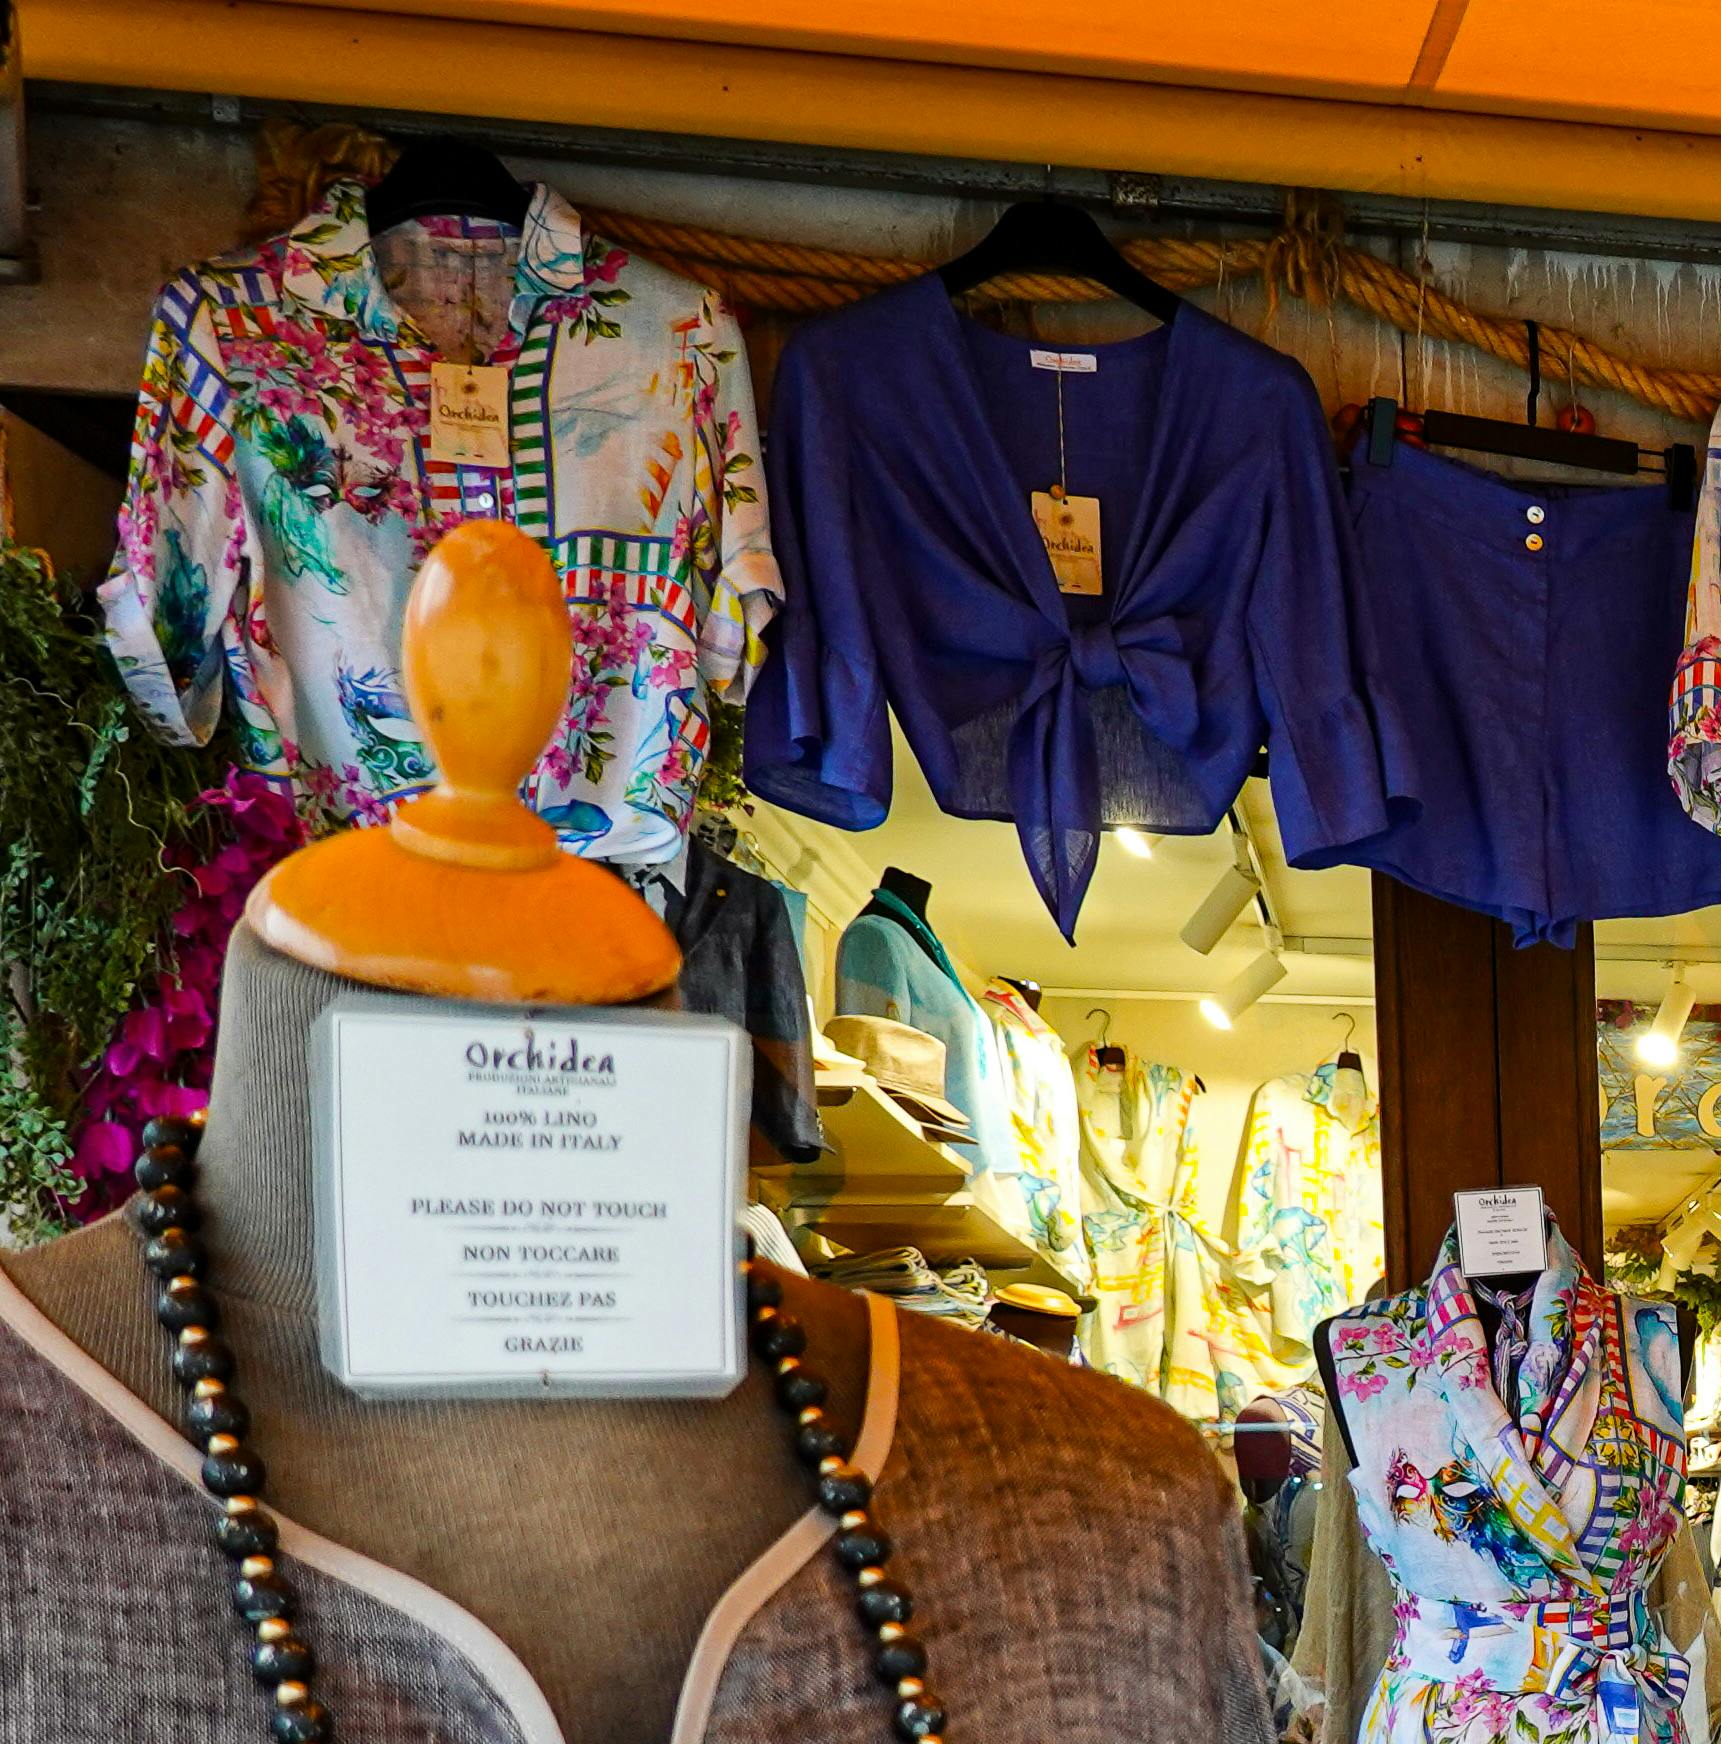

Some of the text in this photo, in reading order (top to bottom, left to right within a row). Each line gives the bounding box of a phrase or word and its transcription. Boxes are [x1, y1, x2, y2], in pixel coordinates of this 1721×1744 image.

[466, 1034, 615, 1074] Orchidea
[484, 1110, 598, 1127] 100% LINO
[458, 1130, 622, 1150] MADE IN ITALY
[411, 1198, 667, 1219] PLEASE DO NOT TOUCH
[463, 1245, 620, 1263] NON TOCCARE
[468, 1291, 617, 1308] TOUCHEZ PAS
[504, 1336, 584, 1353] GRAZIE
